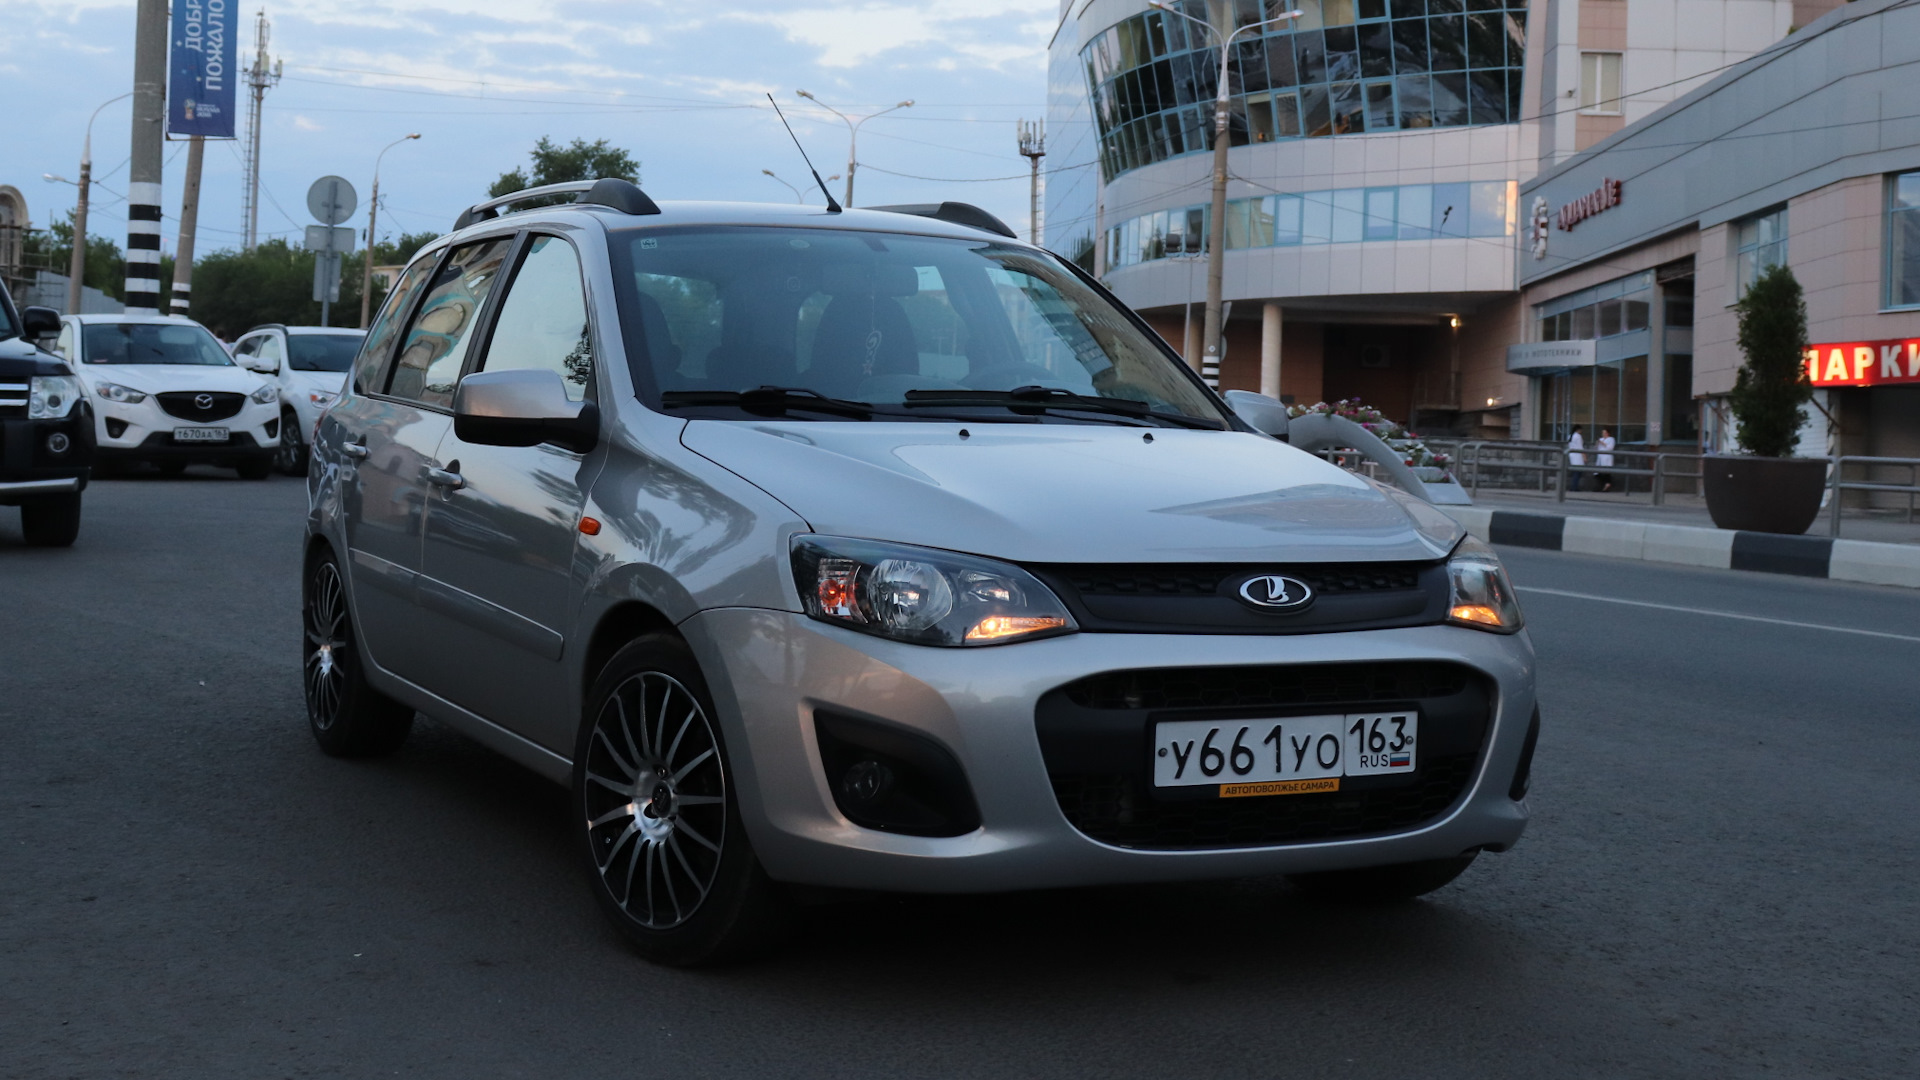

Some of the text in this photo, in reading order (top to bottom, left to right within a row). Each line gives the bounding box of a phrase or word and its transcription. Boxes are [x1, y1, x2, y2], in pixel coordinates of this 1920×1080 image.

[205, 0, 225, 90] ПОЖАЛО
[1171, 716, 1407, 780] У661УО 163
[1360, 754, 1389, 768] RUS
[1225, 781, 1335, 795] АВТОПОВОЛЖЬЕ САМАРА
